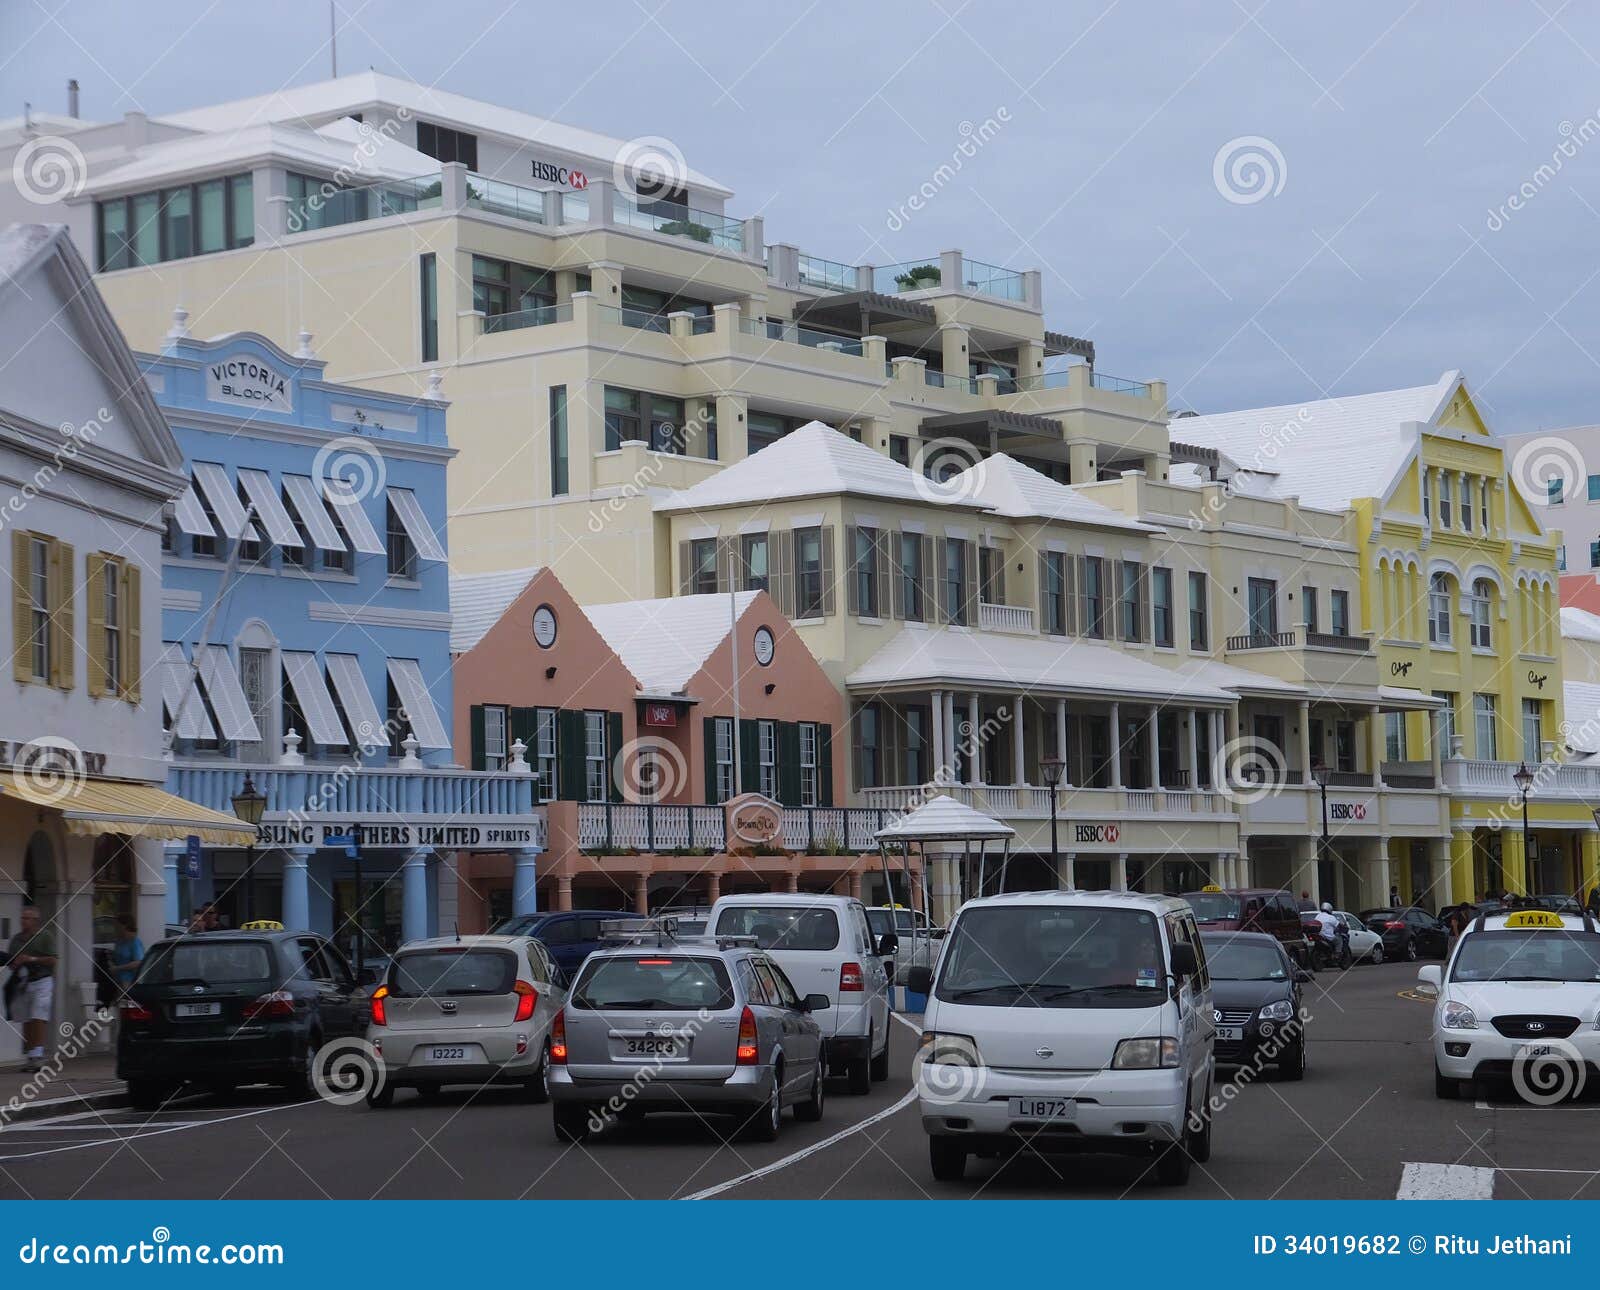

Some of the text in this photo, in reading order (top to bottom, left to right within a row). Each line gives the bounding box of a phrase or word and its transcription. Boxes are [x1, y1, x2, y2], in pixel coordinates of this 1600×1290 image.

[531, 160, 567, 185] HSBC
[211, 362, 285, 395] VICTORIA
[222, 385, 273, 402] BLOCK
[1331, 803, 1354, 819] HSBC
[323, 826, 410, 844] BRTHERS
[418, 826, 480, 844] LIMITED
[487, 829, 530, 842] SPIRITS
[1075, 825, 1104, 842] HSBC
[1519, 915, 1549, 925] TAXI
[432, 1048, 464, 1059] 13223
[1019, 1101, 1066, 1116] L1872
